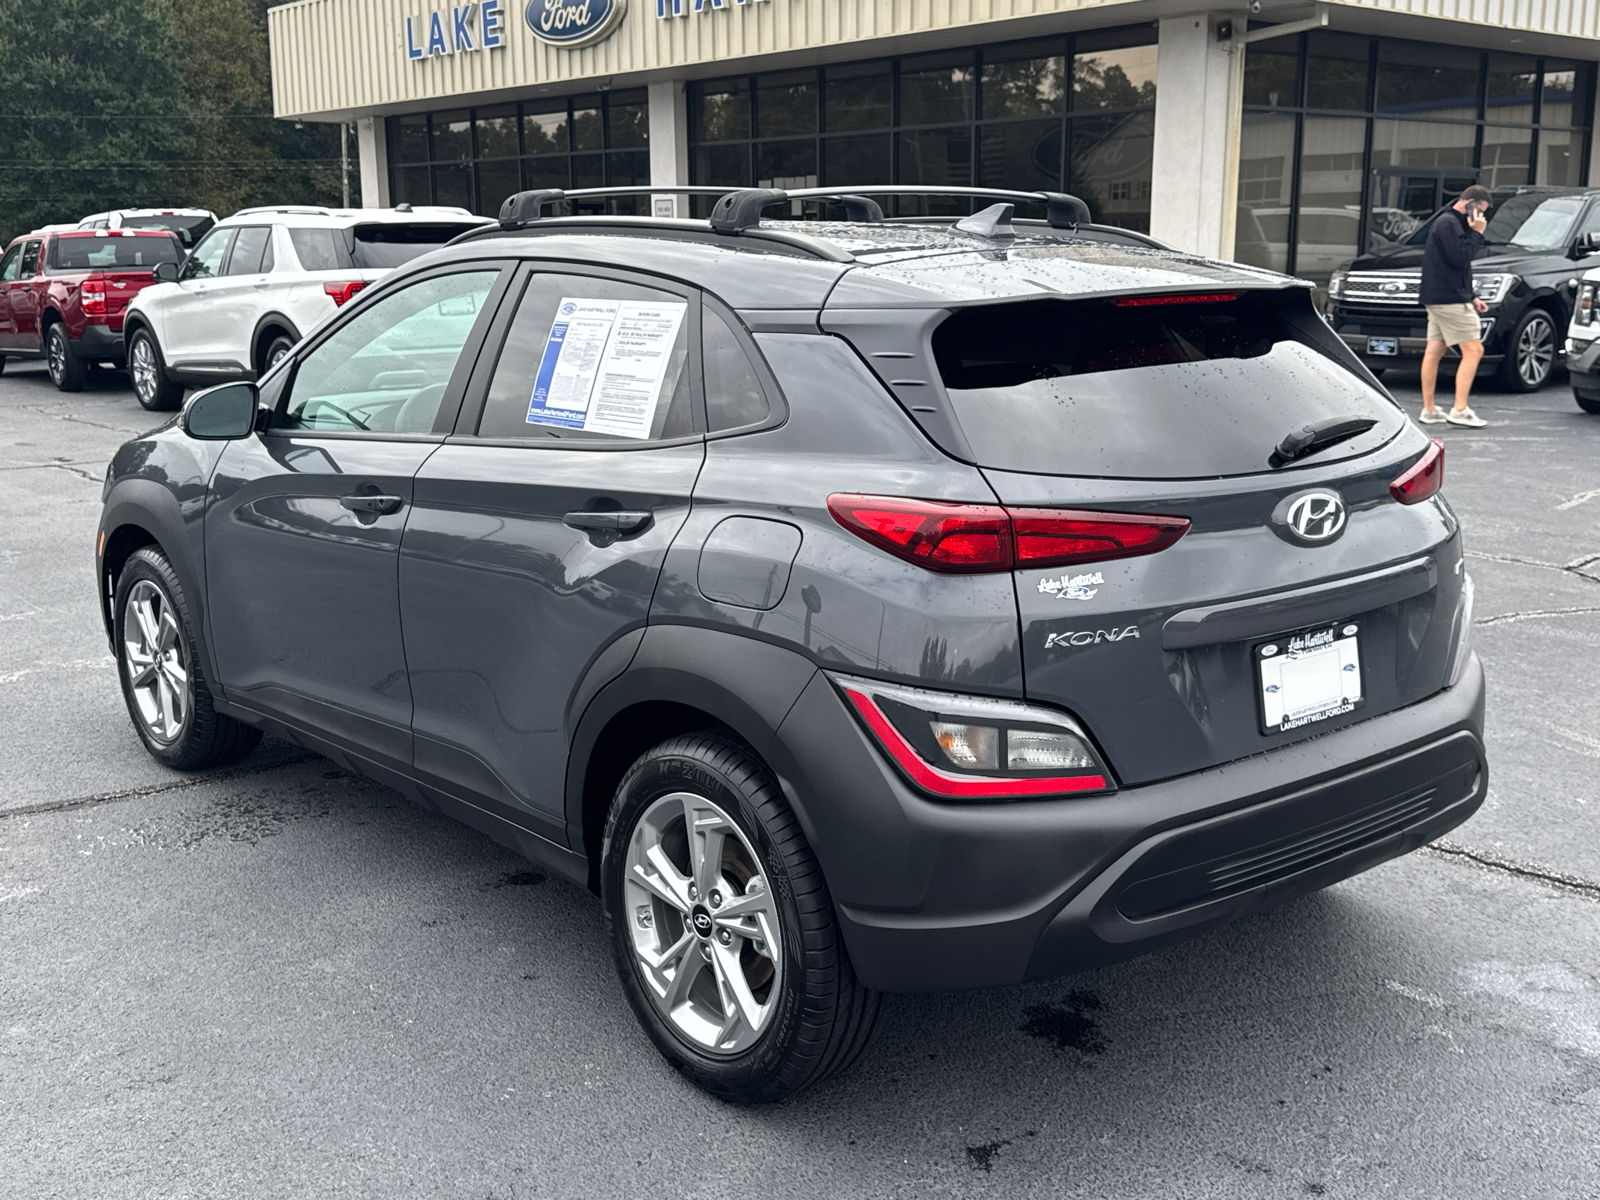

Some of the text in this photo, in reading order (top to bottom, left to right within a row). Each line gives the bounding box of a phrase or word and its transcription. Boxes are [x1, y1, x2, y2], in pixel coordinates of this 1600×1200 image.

[541, 0, 592, 32] Ford
[406, 0, 500, 60] LAKE
[1037, 571, 1105, 594] Lake Hartwell
[1044, 625, 1140, 649] KONA
[1287, 637, 1304, 654] Lake
[1304, 629, 1334, 648] Hartwell
[1280, 703, 1354, 732] LAKEHARTWELLFORD.COM
